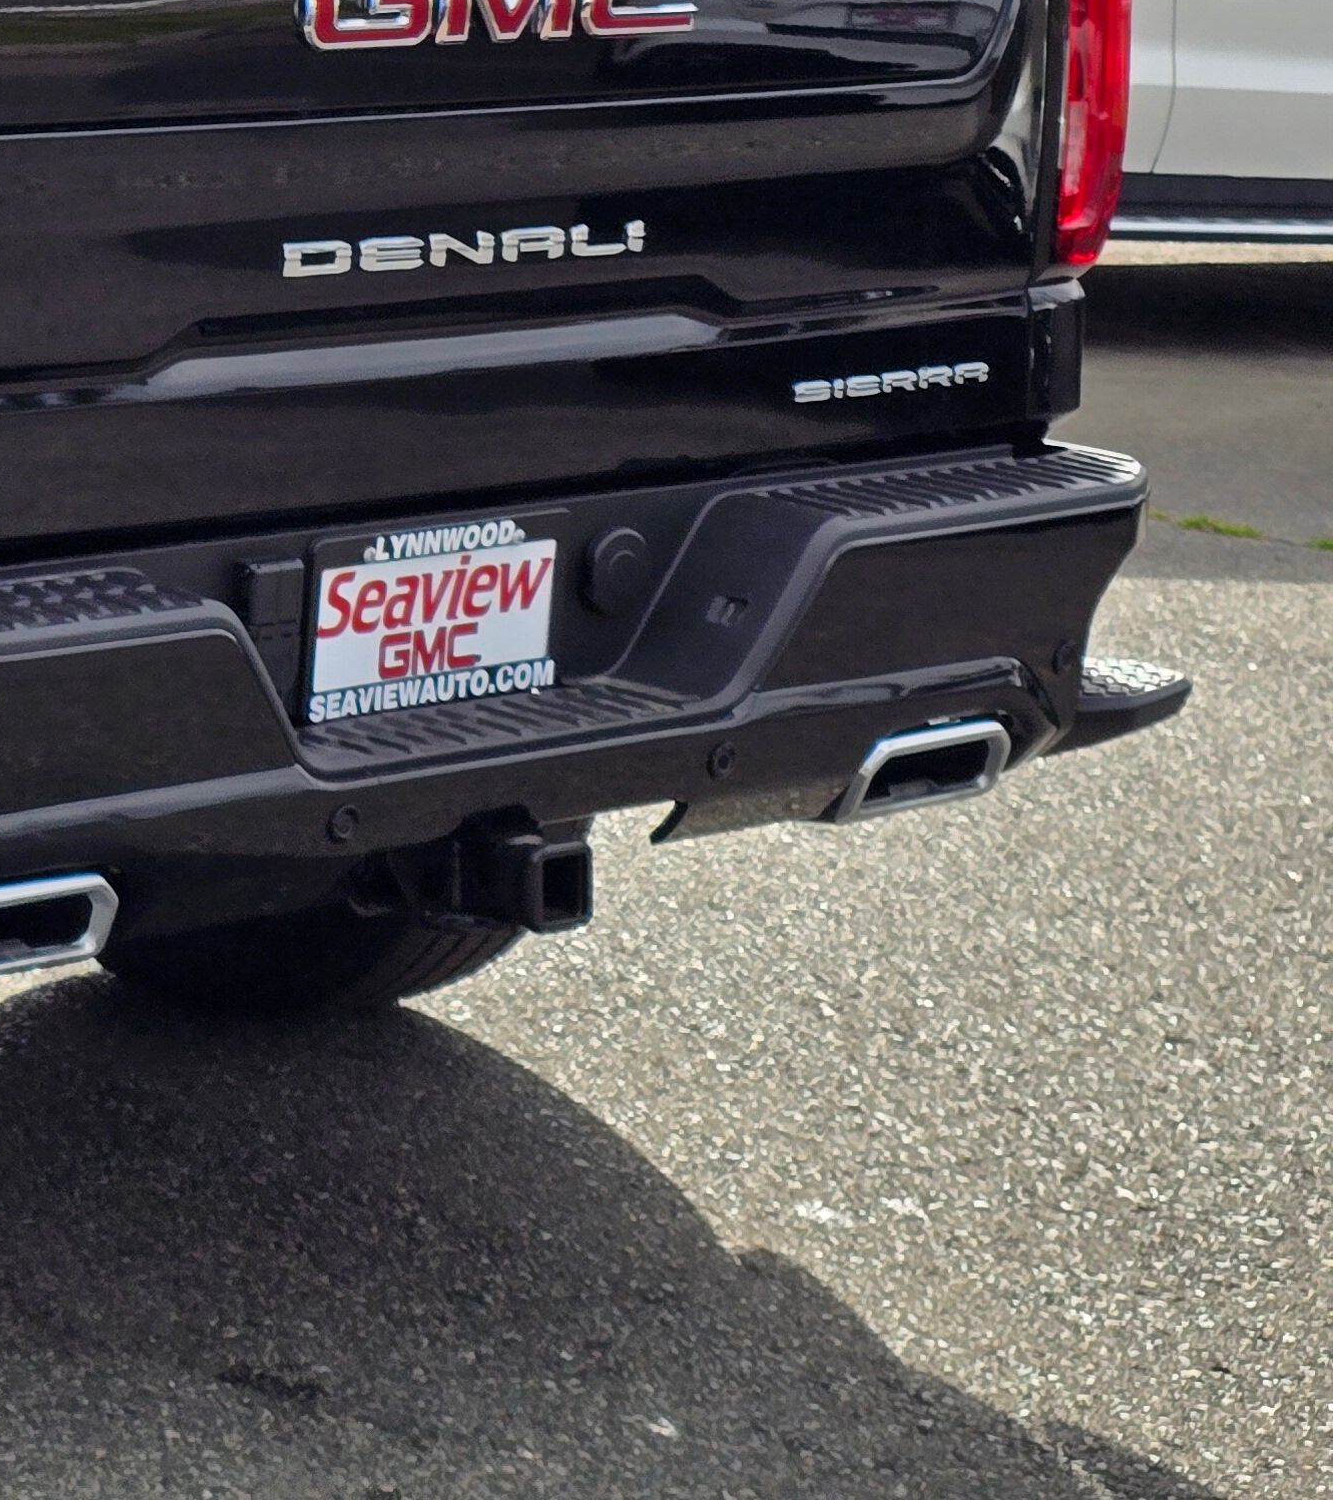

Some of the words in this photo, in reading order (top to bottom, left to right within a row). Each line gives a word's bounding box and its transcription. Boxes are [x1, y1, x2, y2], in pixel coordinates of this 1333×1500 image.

[282, 219, 645, 279] DENALI
[792, 360, 991, 404] SIERRA
[374, 519, 517, 561] LYNNWOOD
[317, 555, 553, 639] Seaview
[378, 621, 482, 680] GMC
[308, 659, 556, 724] SEAVIEWAUTO.COM
